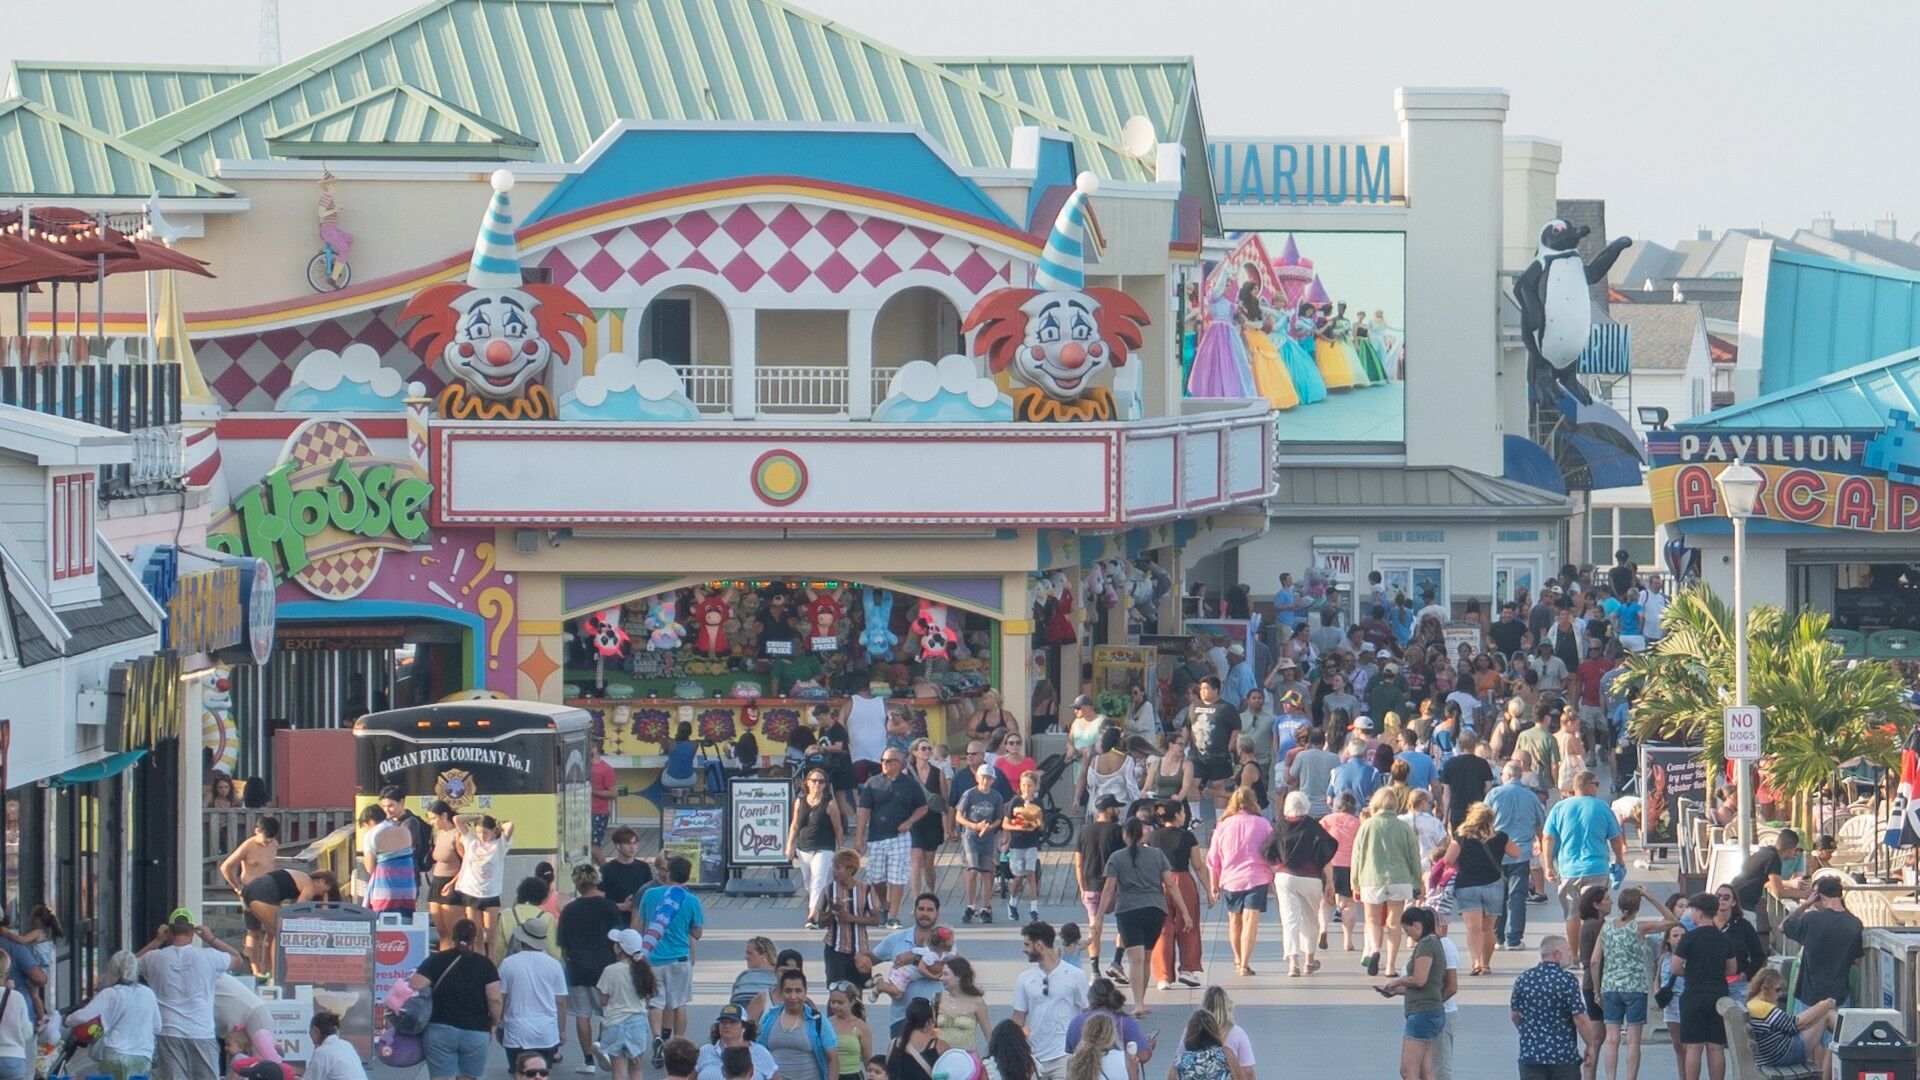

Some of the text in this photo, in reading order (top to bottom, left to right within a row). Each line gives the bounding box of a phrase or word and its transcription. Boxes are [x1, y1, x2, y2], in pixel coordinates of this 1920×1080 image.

[1680, 434, 1852, 461] PAVILION
[1731, 713, 1753, 728] NO
[1730, 731, 1756, 740] DOGS
[1728, 743, 1758, 752] ALLOWED
[379, 747, 532, 776] OCEAN FIRE COMPANY No. 1
[740, 804, 781, 819] Come in
[740, 823, 782, 856] Open
[281, 932, 371, 948] HAPPY HOUR
